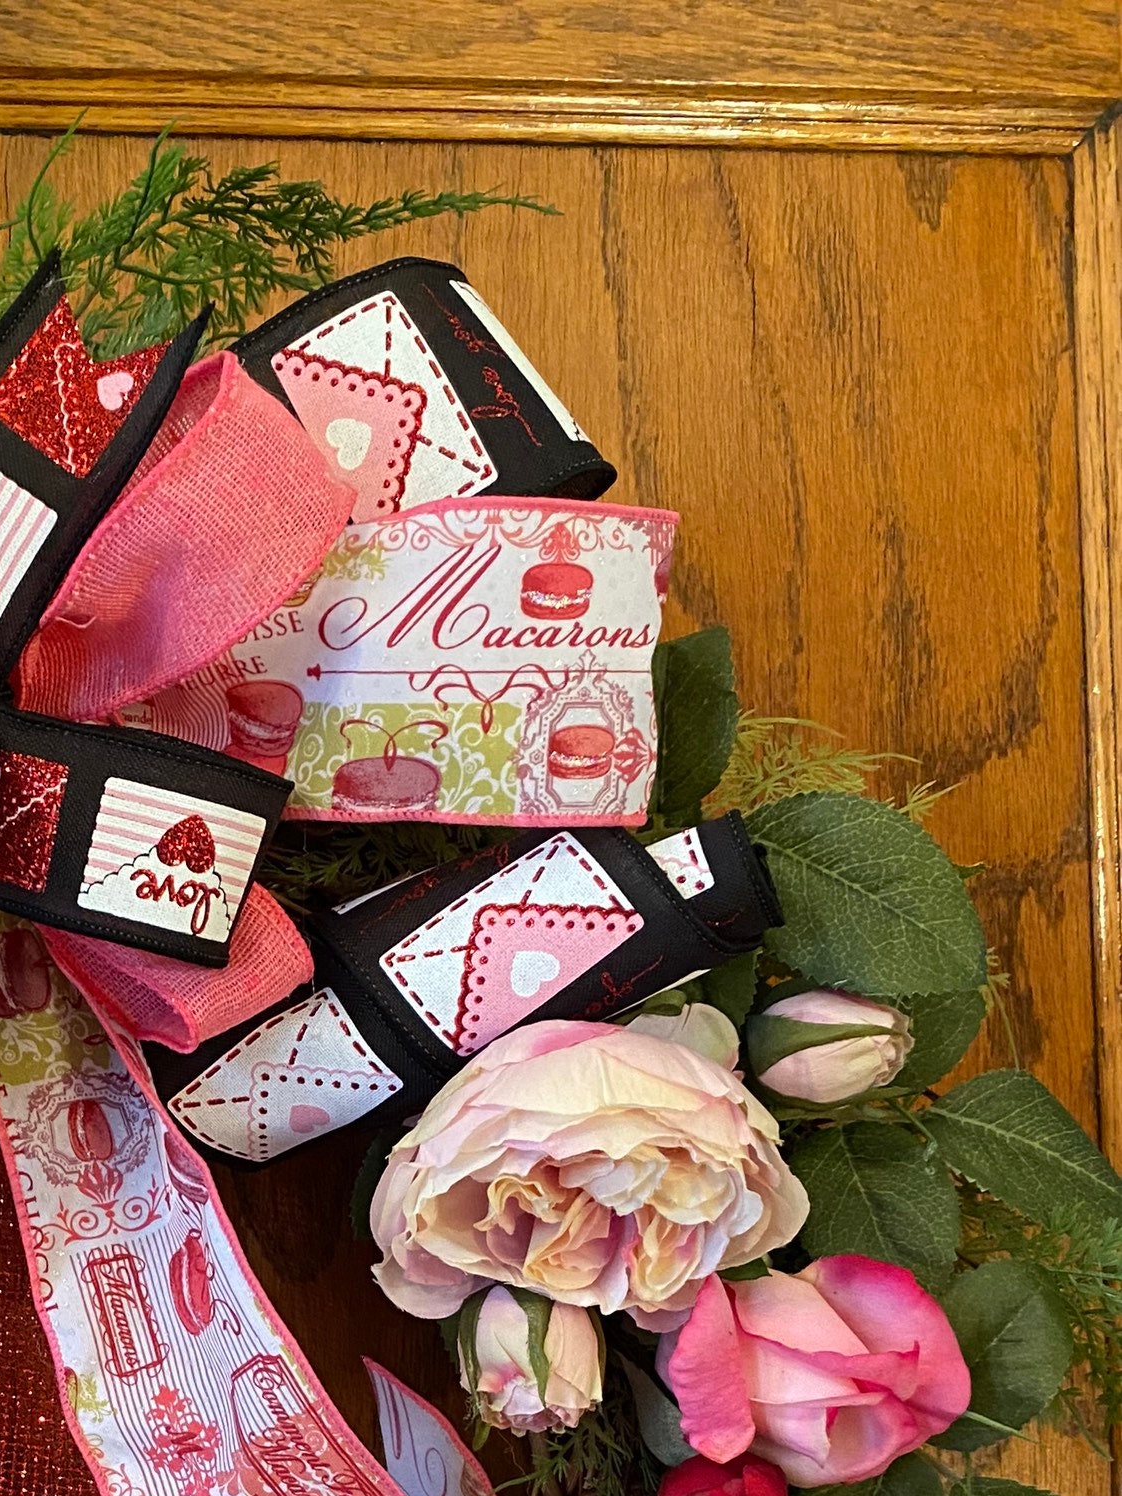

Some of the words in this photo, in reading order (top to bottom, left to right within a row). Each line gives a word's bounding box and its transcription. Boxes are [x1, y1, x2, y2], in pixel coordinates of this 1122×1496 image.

[319, 543, 656, 651] Macarons
[130, 868, 221, 935] love
[99, 1264, 138, 1367] Macarons
[252, 1373, 328, 1470] Comment
